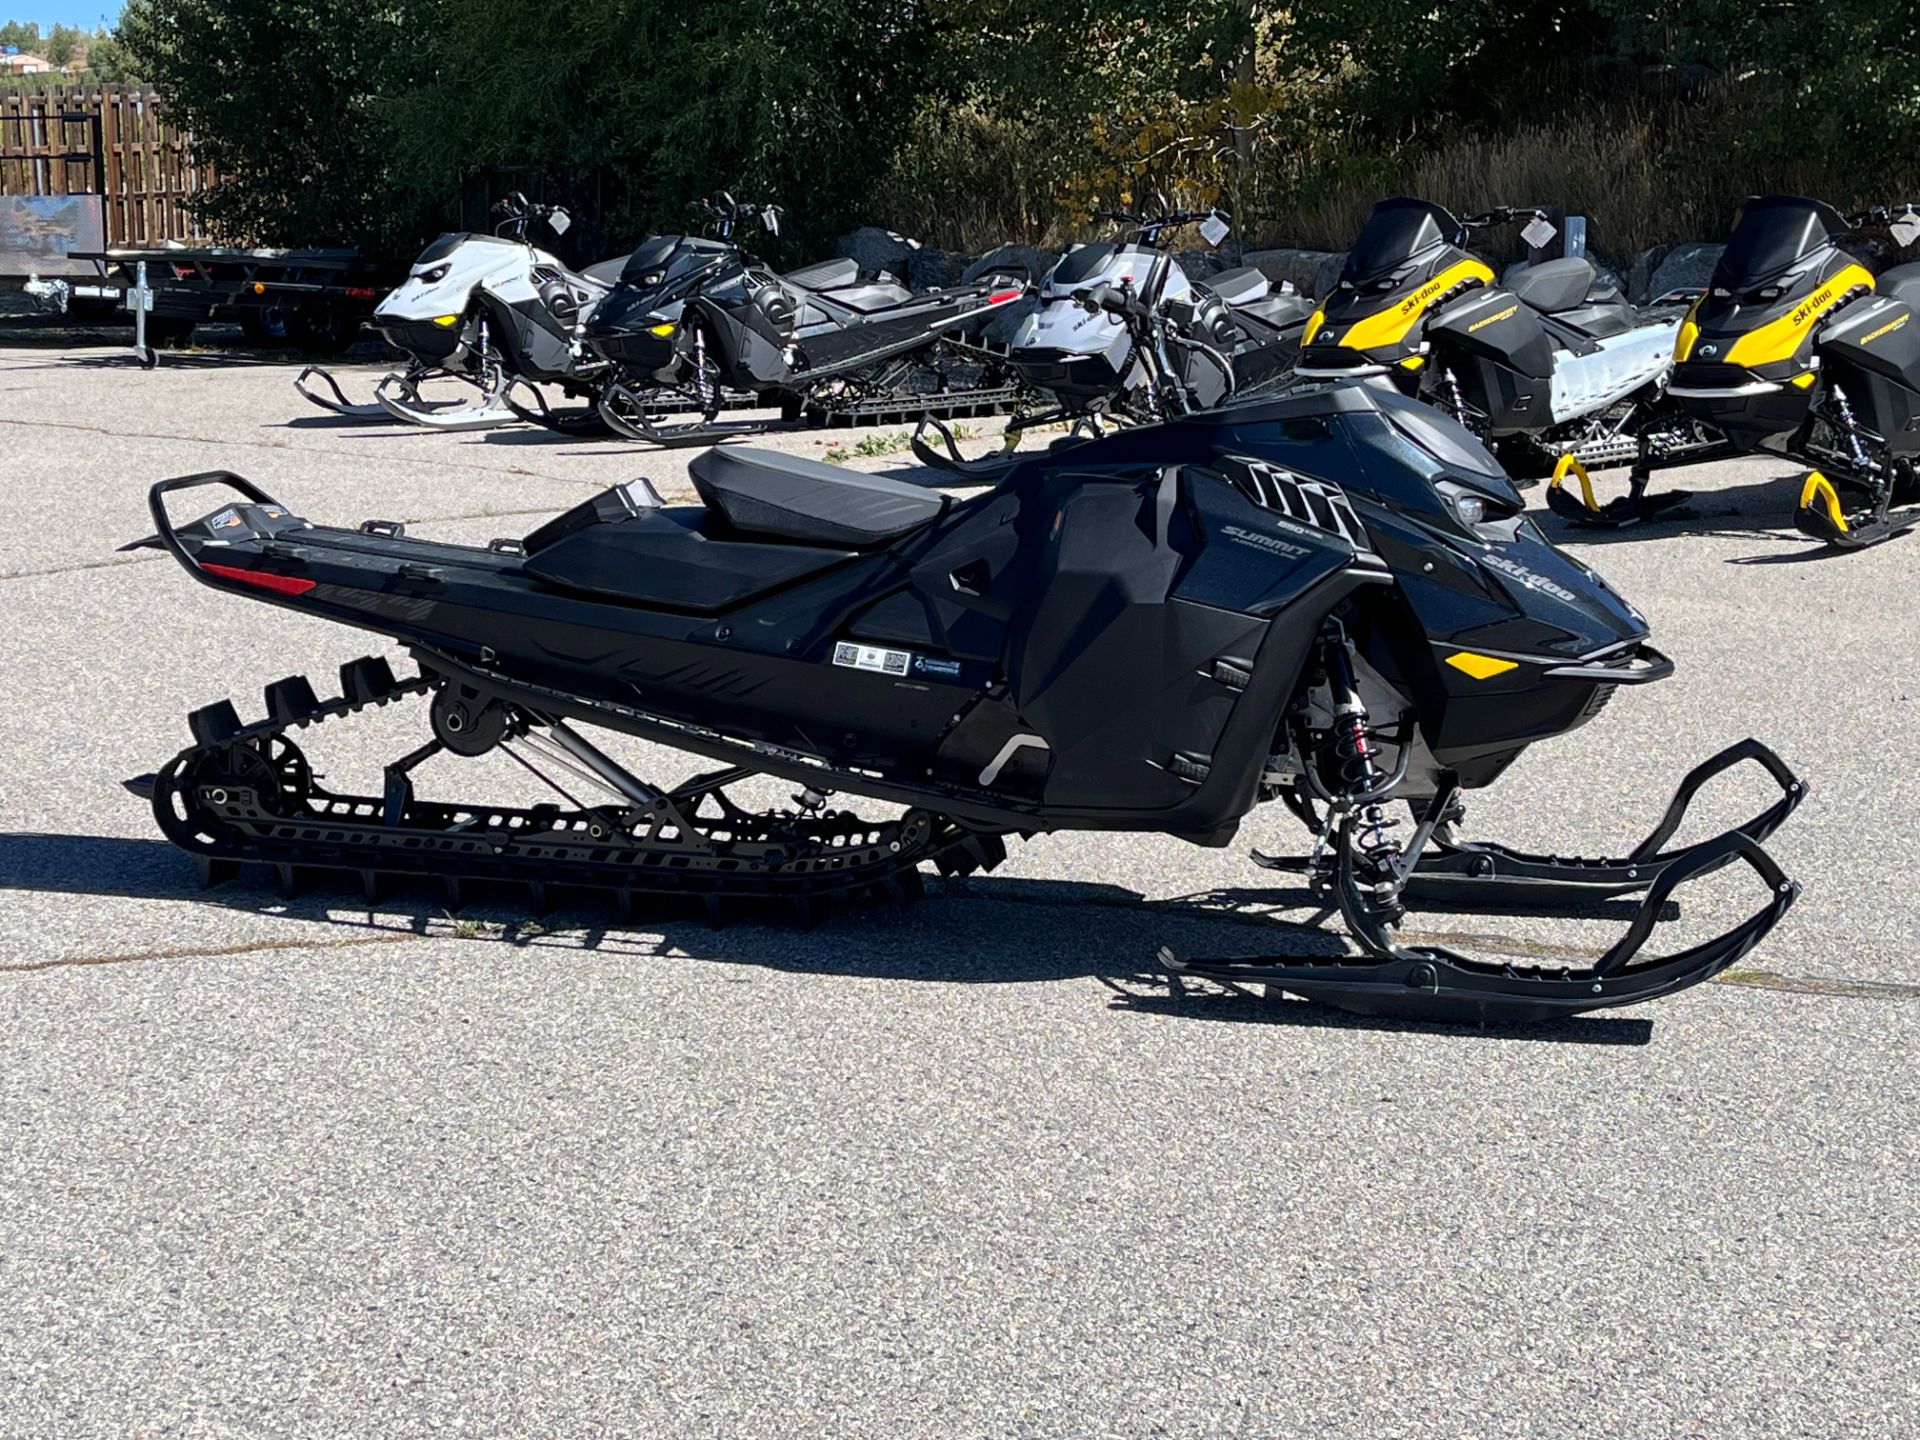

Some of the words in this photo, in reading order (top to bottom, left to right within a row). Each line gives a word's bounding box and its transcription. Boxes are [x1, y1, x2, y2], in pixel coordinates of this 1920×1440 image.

[1402, 282, 1440, 315] ski-doo
[1793, 290, 1832, 327] ski-doo
[1220, 525, 1312, 556] SUMMIT
[1482, 553, 1577, 601] ski-doo
